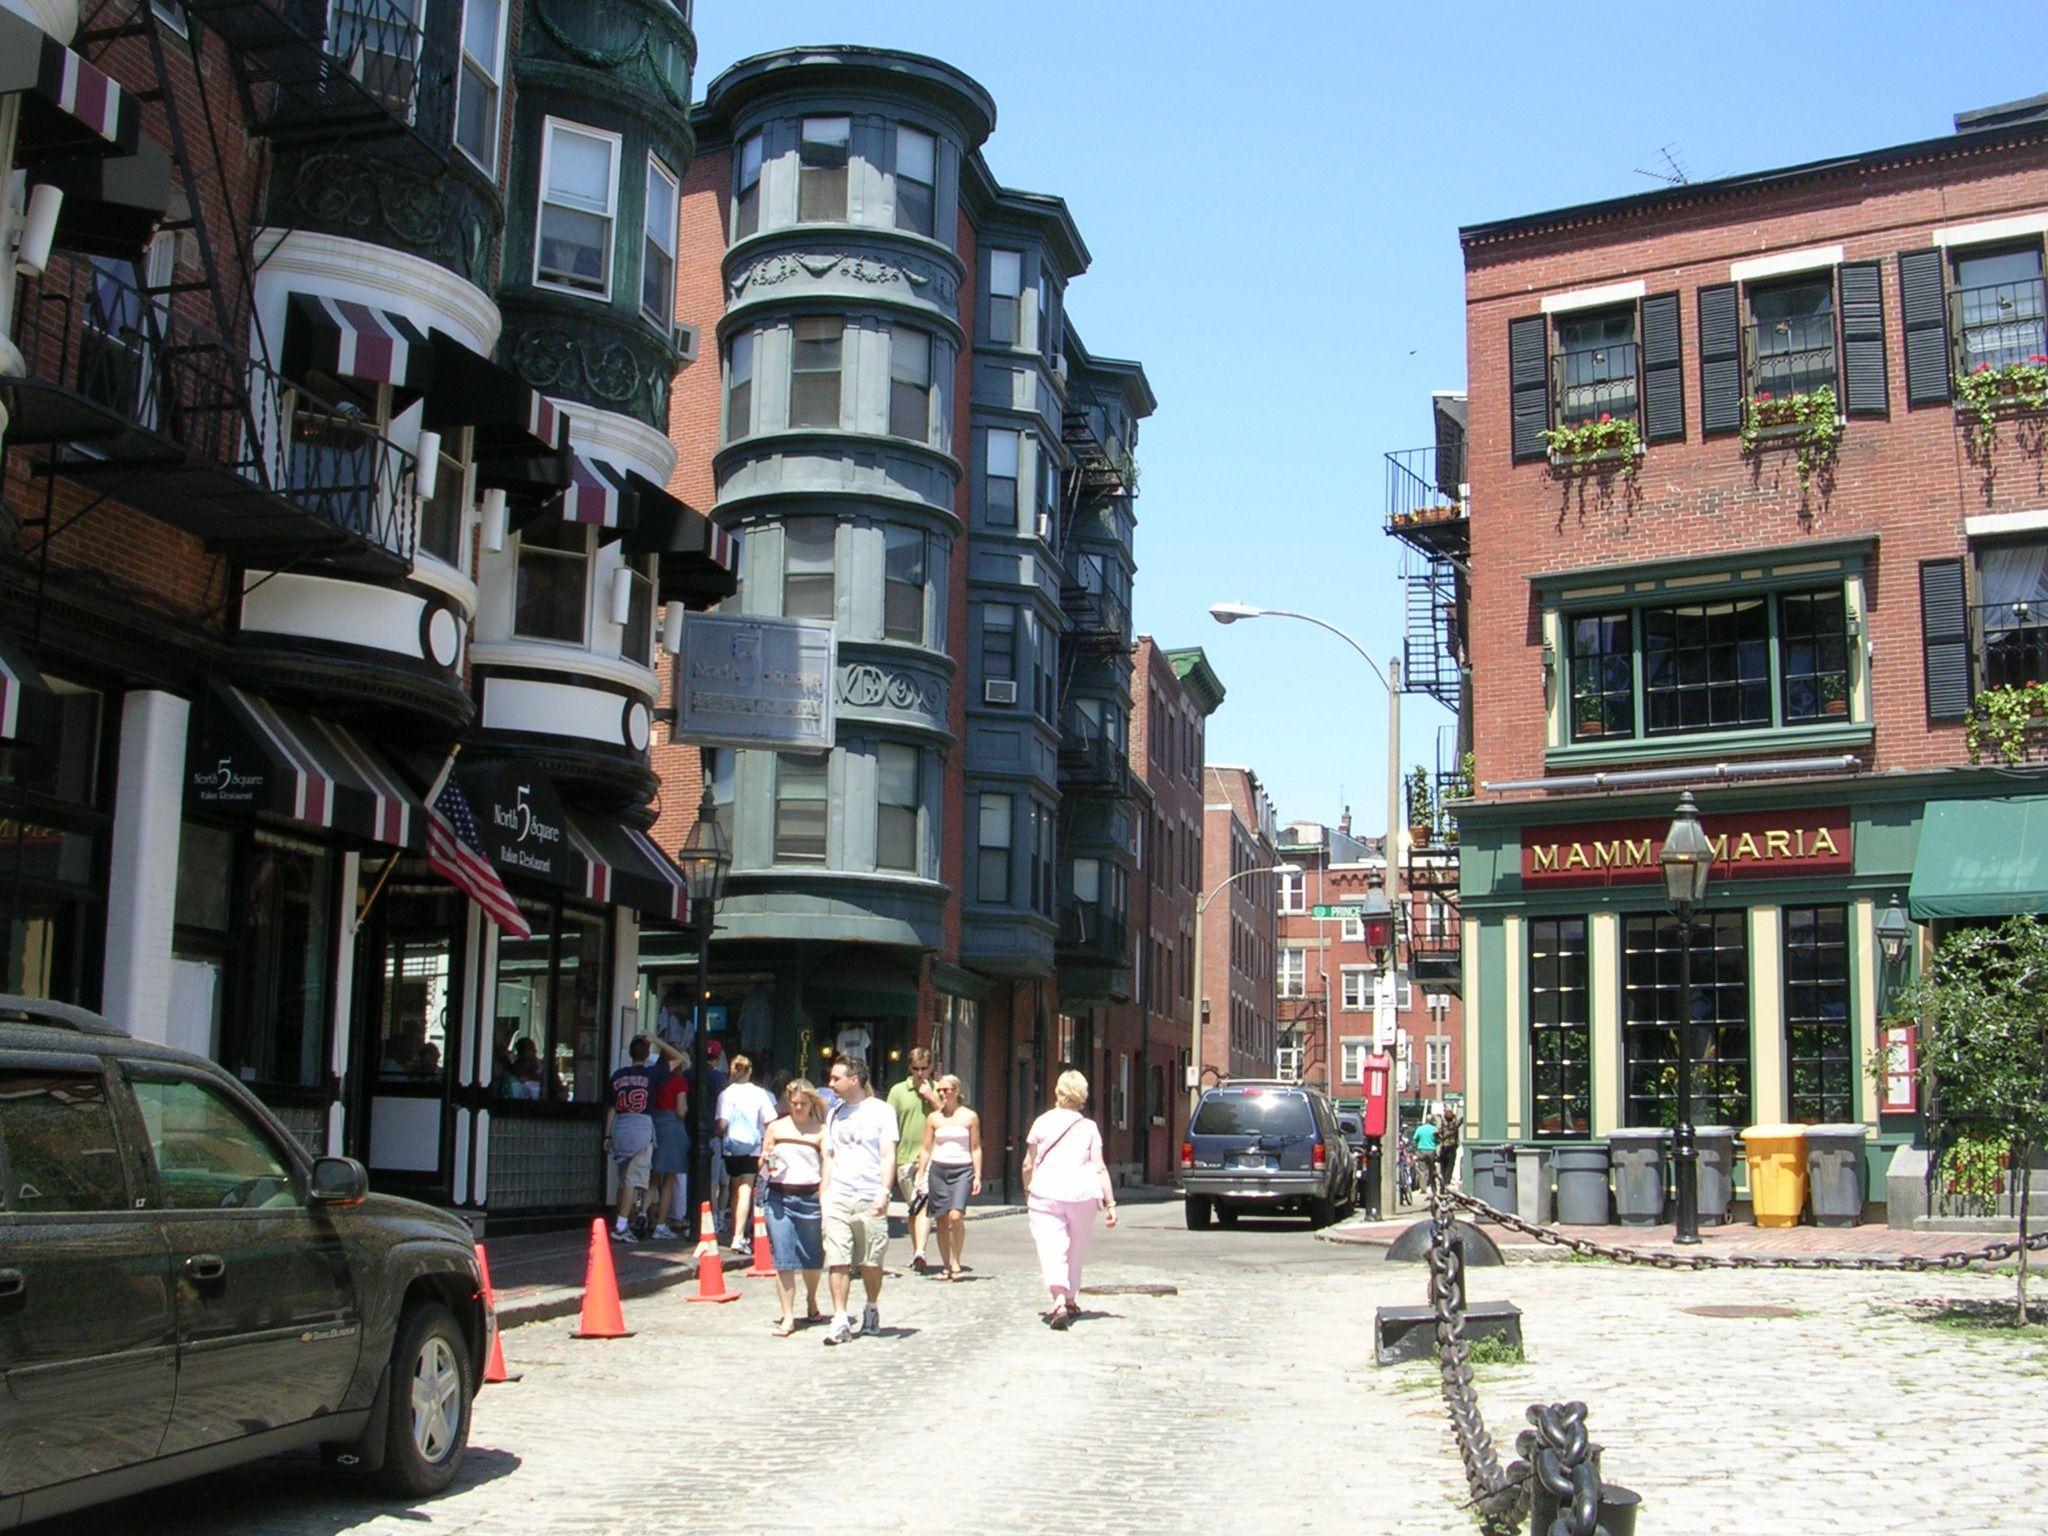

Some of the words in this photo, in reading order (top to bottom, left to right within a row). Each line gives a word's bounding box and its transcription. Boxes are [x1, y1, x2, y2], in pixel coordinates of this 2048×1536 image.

[194, 773, 218, 784] North
[218, 756, 231, 790] 5
[231, 774, 263, 787] Square
[494, 804, 518, 829] North
[517, 784, 530, 842] 5
[530, 815, 560, 843] Square
[1532, 838, 1663, 872] MAMM
[1703, 828, 1839, 862] MARIA
[1331, 906, 1361, 918] PRINCE
